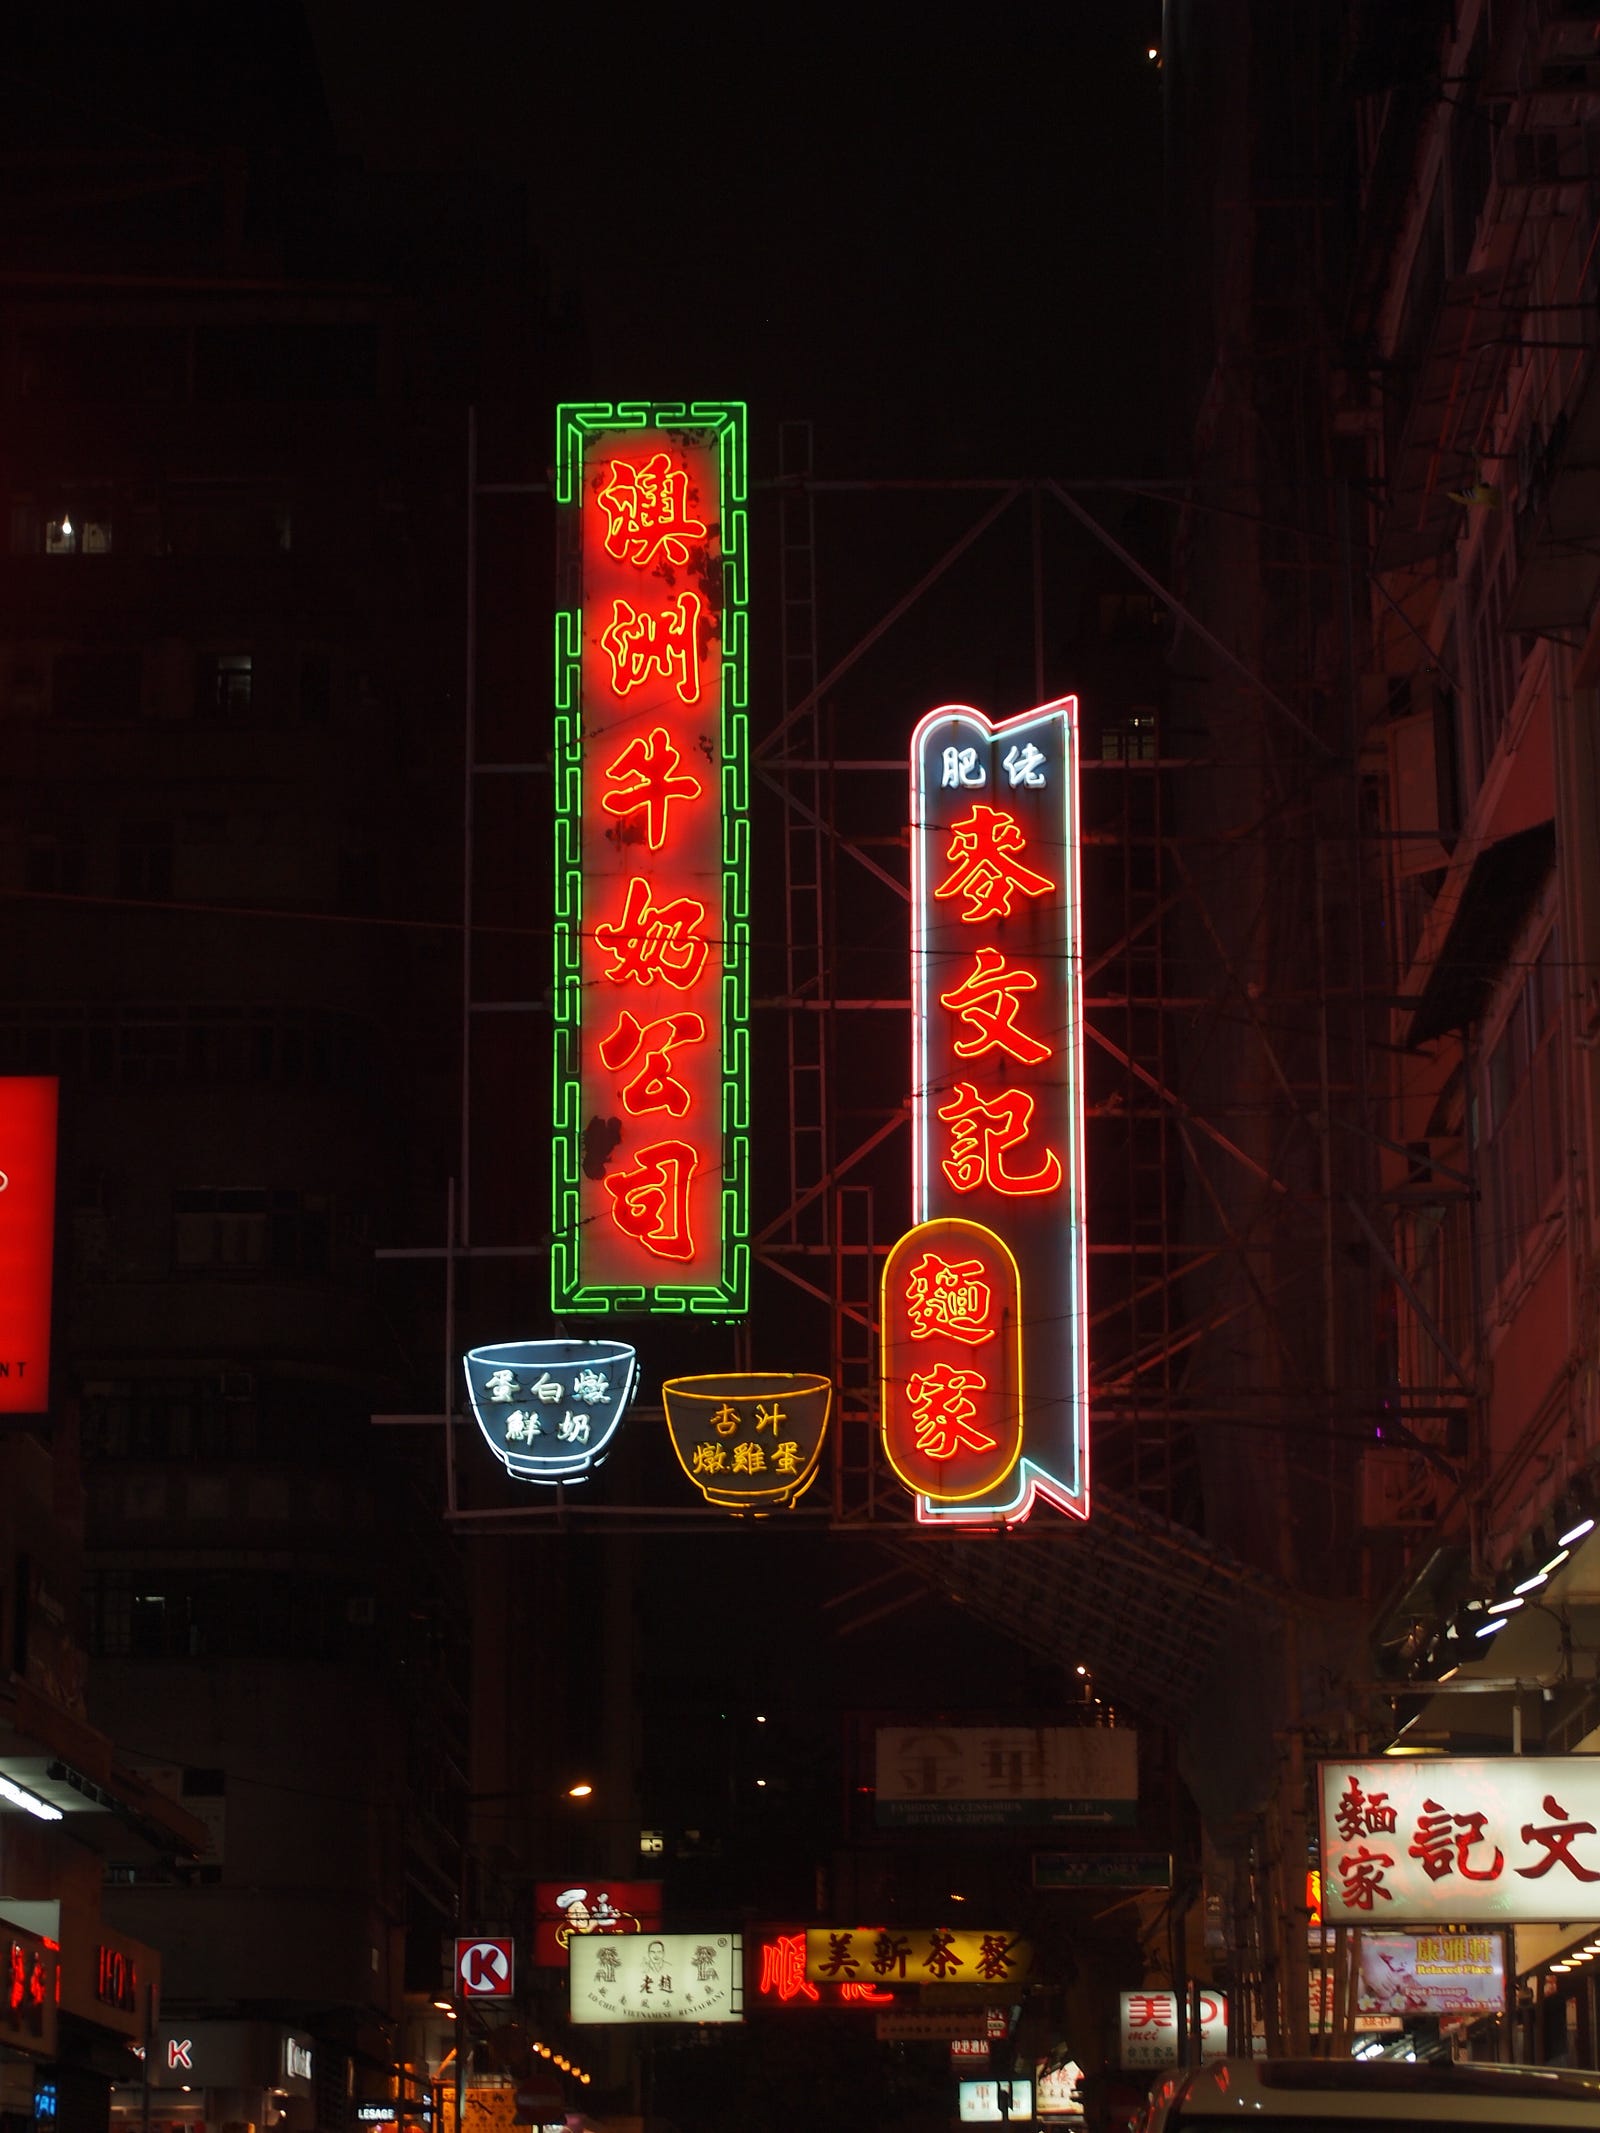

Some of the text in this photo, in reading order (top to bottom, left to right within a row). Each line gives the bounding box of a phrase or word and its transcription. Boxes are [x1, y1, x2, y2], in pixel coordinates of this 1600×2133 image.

[940, 744, 1048, 789] 肥佬
[595, 453, 708, 1260] 澳洲牛奶公司
[934, 805, 1062, 1196] 麥文記
[505, 1409, 592, 1446] 鮮奶
[709, 1403, 789, 1438] 杏汁
[470, 1947, 505, 1986] K
[1416, 1964, 1493, 1975] Relaxed Place
[622, 2009, 673, 2020] VIETNAMESE
[678, 1989, 727, 2016] RESTAURANT
[1429, 1987, 1467, 1998] Massage
[1128, 1995, 1172, 2027] 美
[358, 2109, 395, 2120] LESAGE
